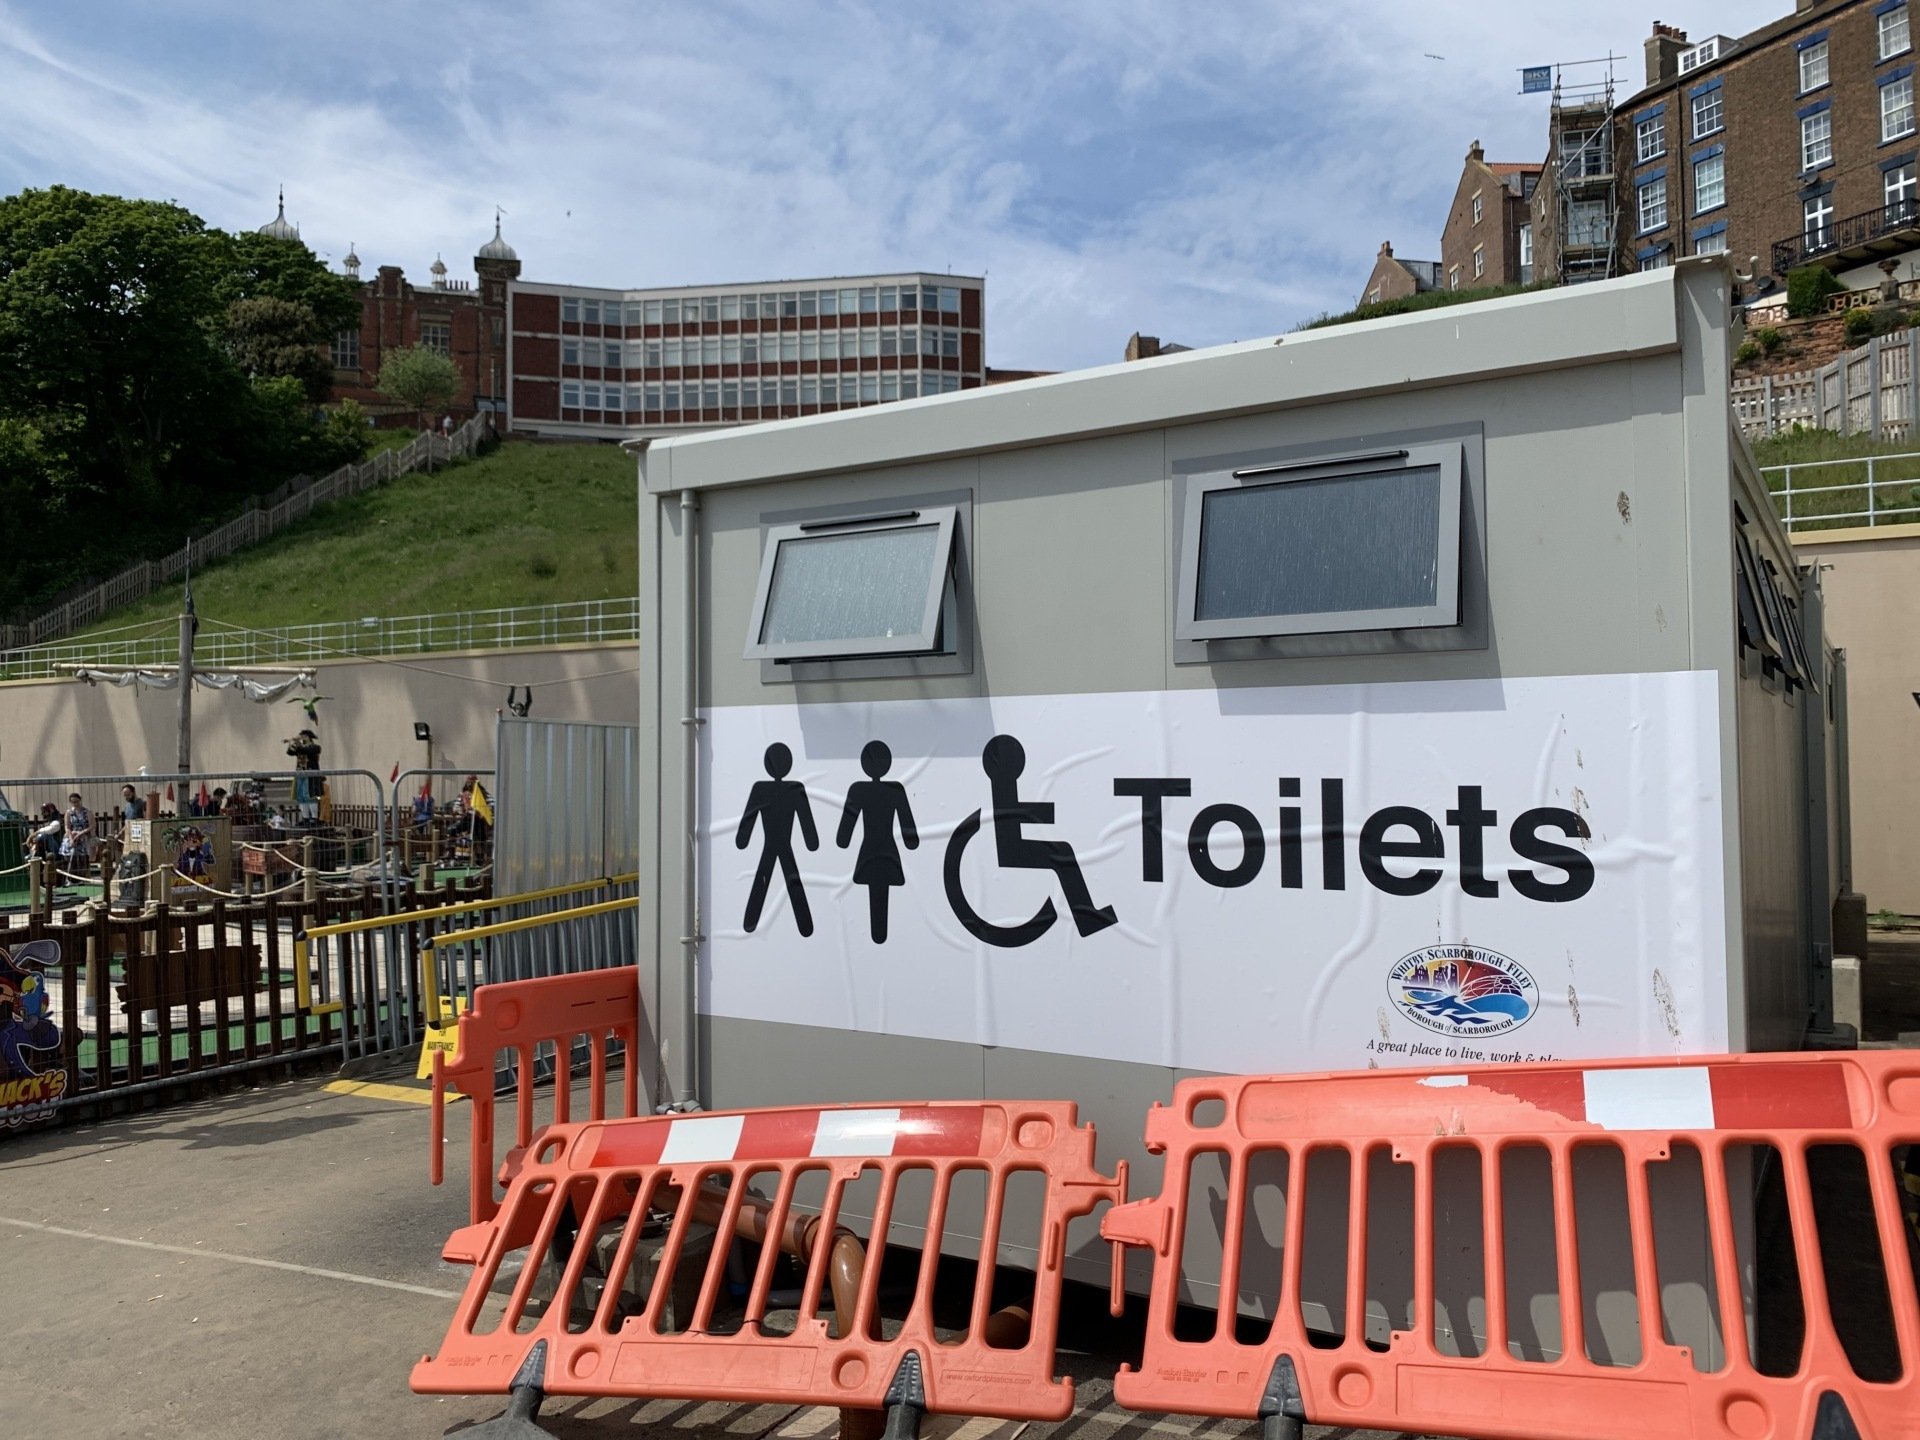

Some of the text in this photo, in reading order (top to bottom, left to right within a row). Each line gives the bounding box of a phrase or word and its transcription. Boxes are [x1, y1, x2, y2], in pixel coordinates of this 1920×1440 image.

[1113, 777, 1595, 903] Toilets
[1391, 949, 1533, 990] WHITBY SCARBOROUGH FILEY
[1406, 1007, 1513, 1035] BOROUGH of SCARBOROUGH
[1366, 1039, 1375, 1050] A
[1378, 1041, 1407, 1053] great
[1410, 1042, 1442, 1056] place
[1445, 1047, 1457, 1058] to
[1460, 1047, 1485, 1062] live,
[1490, 1051, 1521, 1062] work
